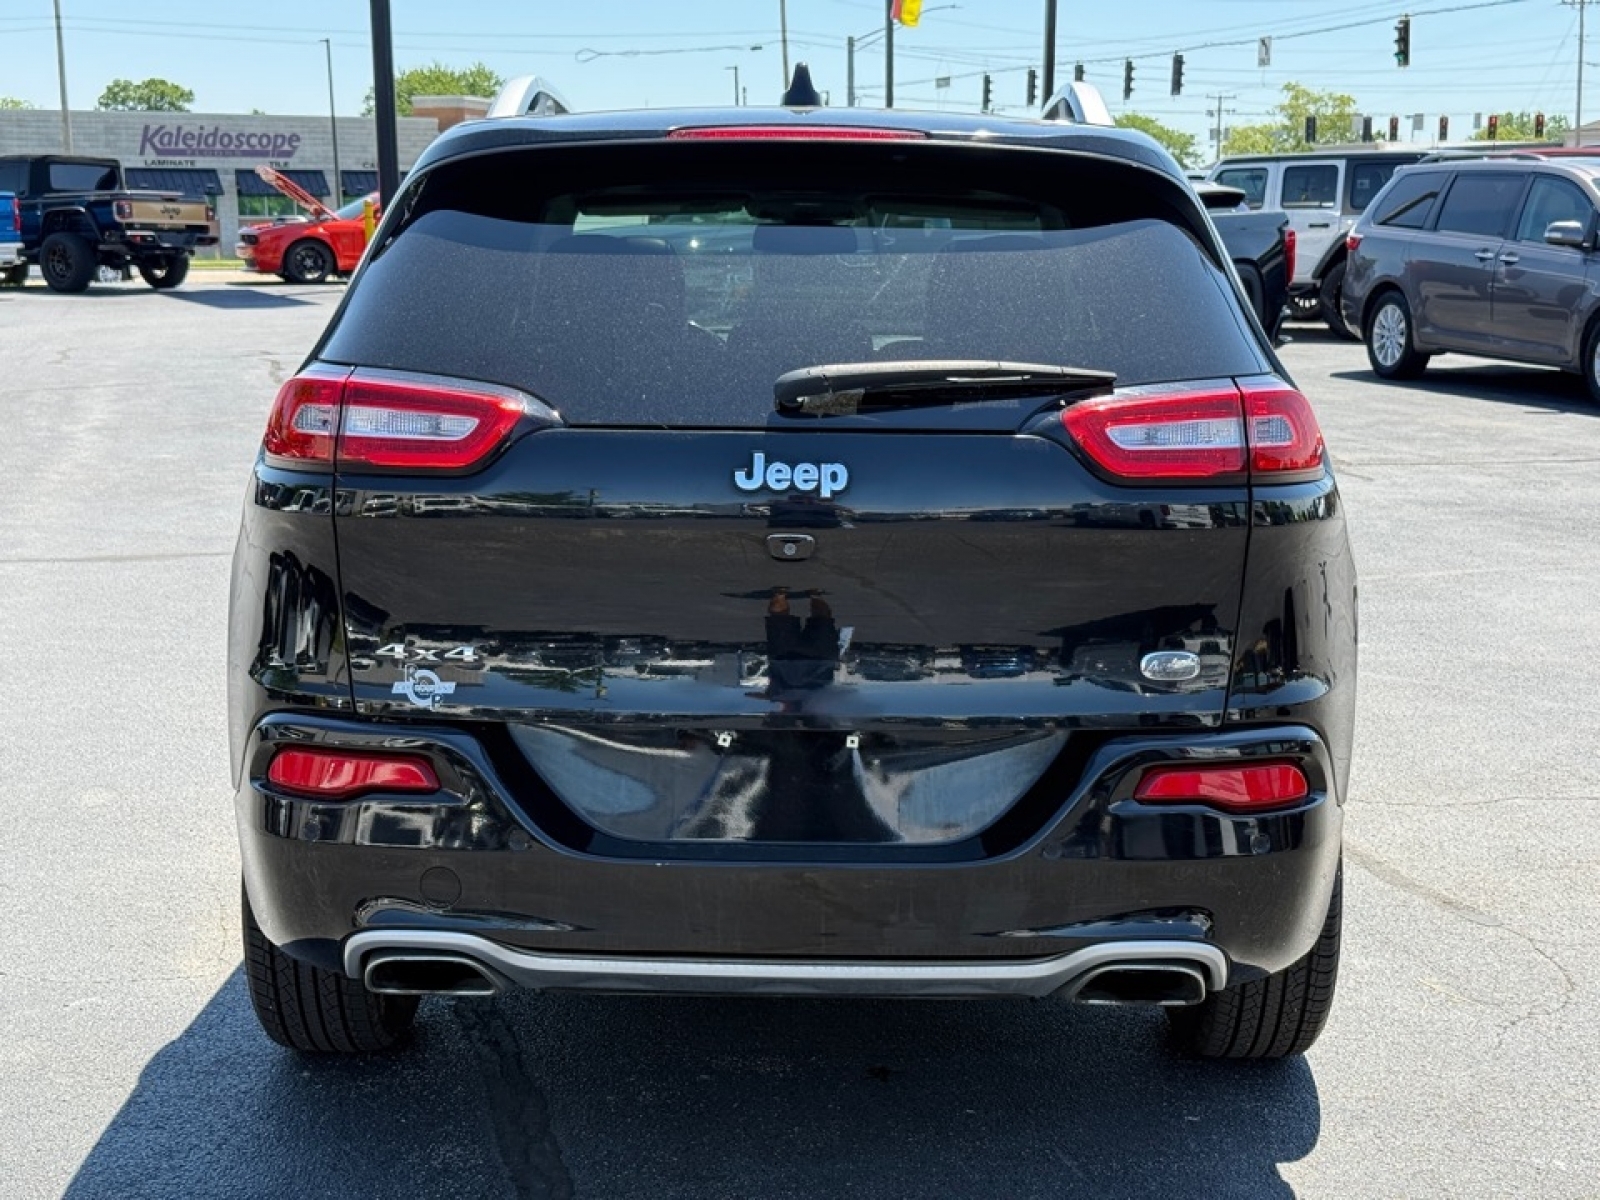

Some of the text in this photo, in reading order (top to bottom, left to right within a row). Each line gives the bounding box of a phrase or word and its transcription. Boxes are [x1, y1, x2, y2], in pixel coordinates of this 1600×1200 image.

[139, 125, 301, 158] Kaleidoscope
[144, 159, 196, 167] LAMINATE
[734, 452, 848, 498] Jeep
[375, 643, 479, 662] 4x4
